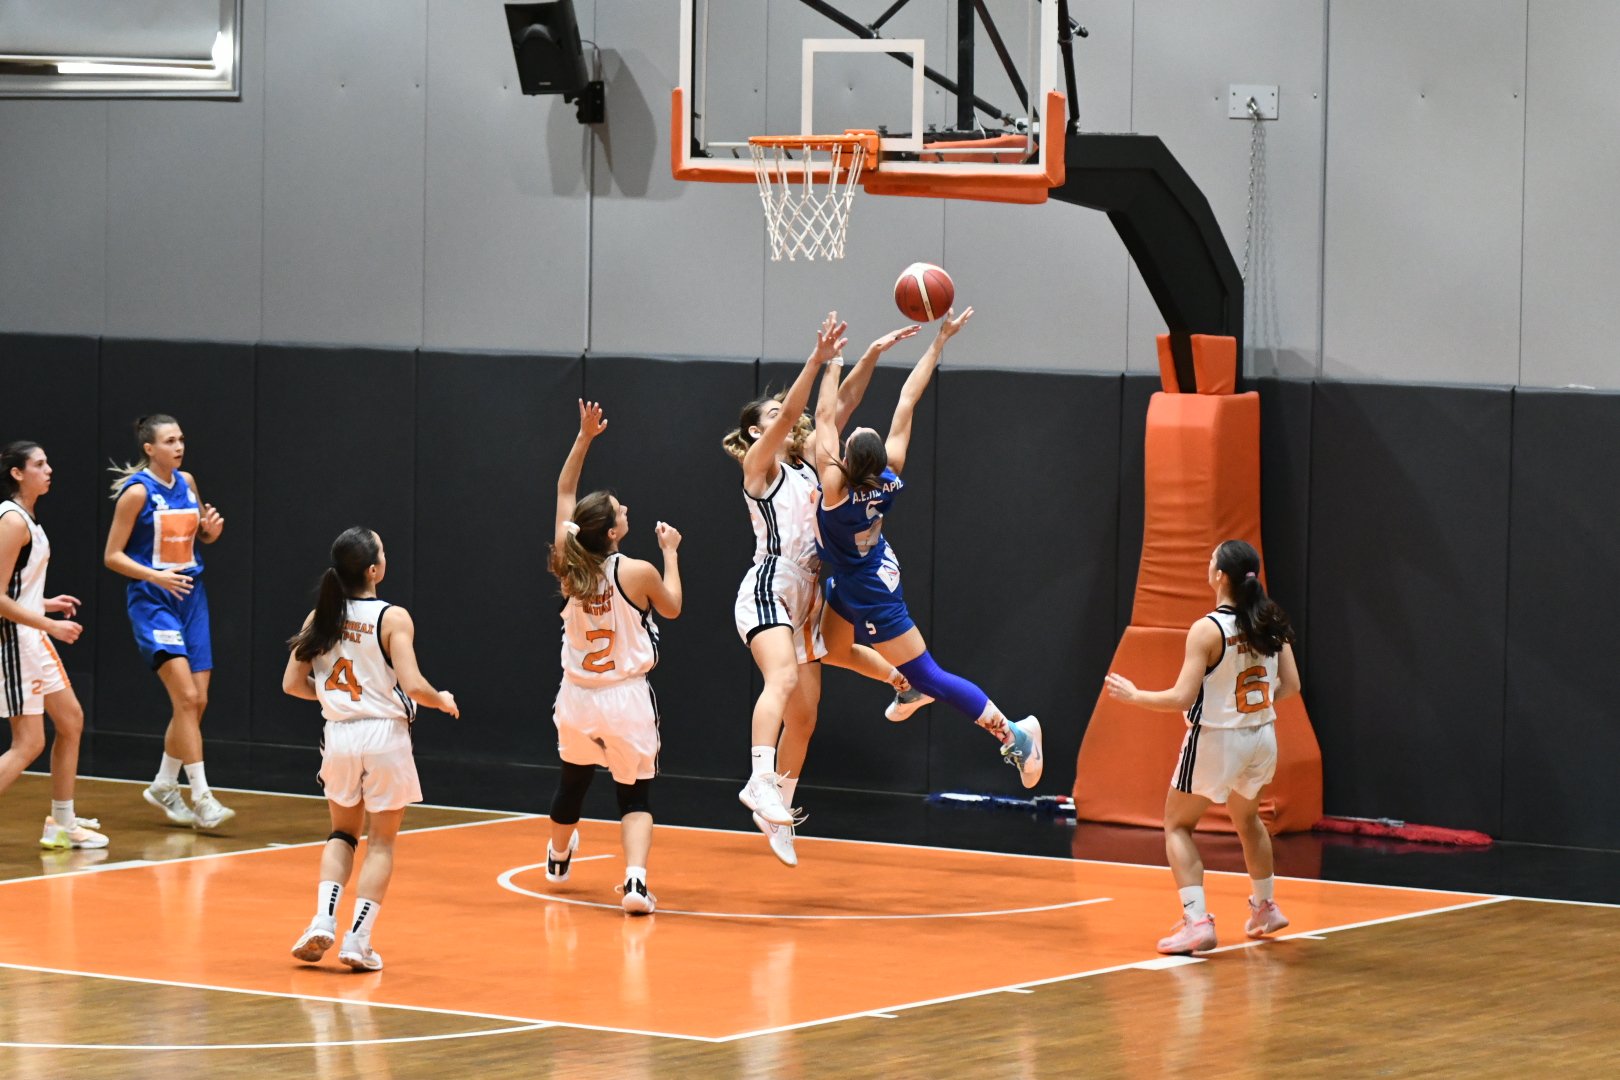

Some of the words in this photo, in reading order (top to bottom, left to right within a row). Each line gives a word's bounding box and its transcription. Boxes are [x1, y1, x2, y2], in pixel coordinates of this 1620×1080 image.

[582, 628, 616, 674] 2
[31, 679, 43, 695] 2
[325, 656, 363, 702] 4
[1235, 665, 1272, 714] 6
